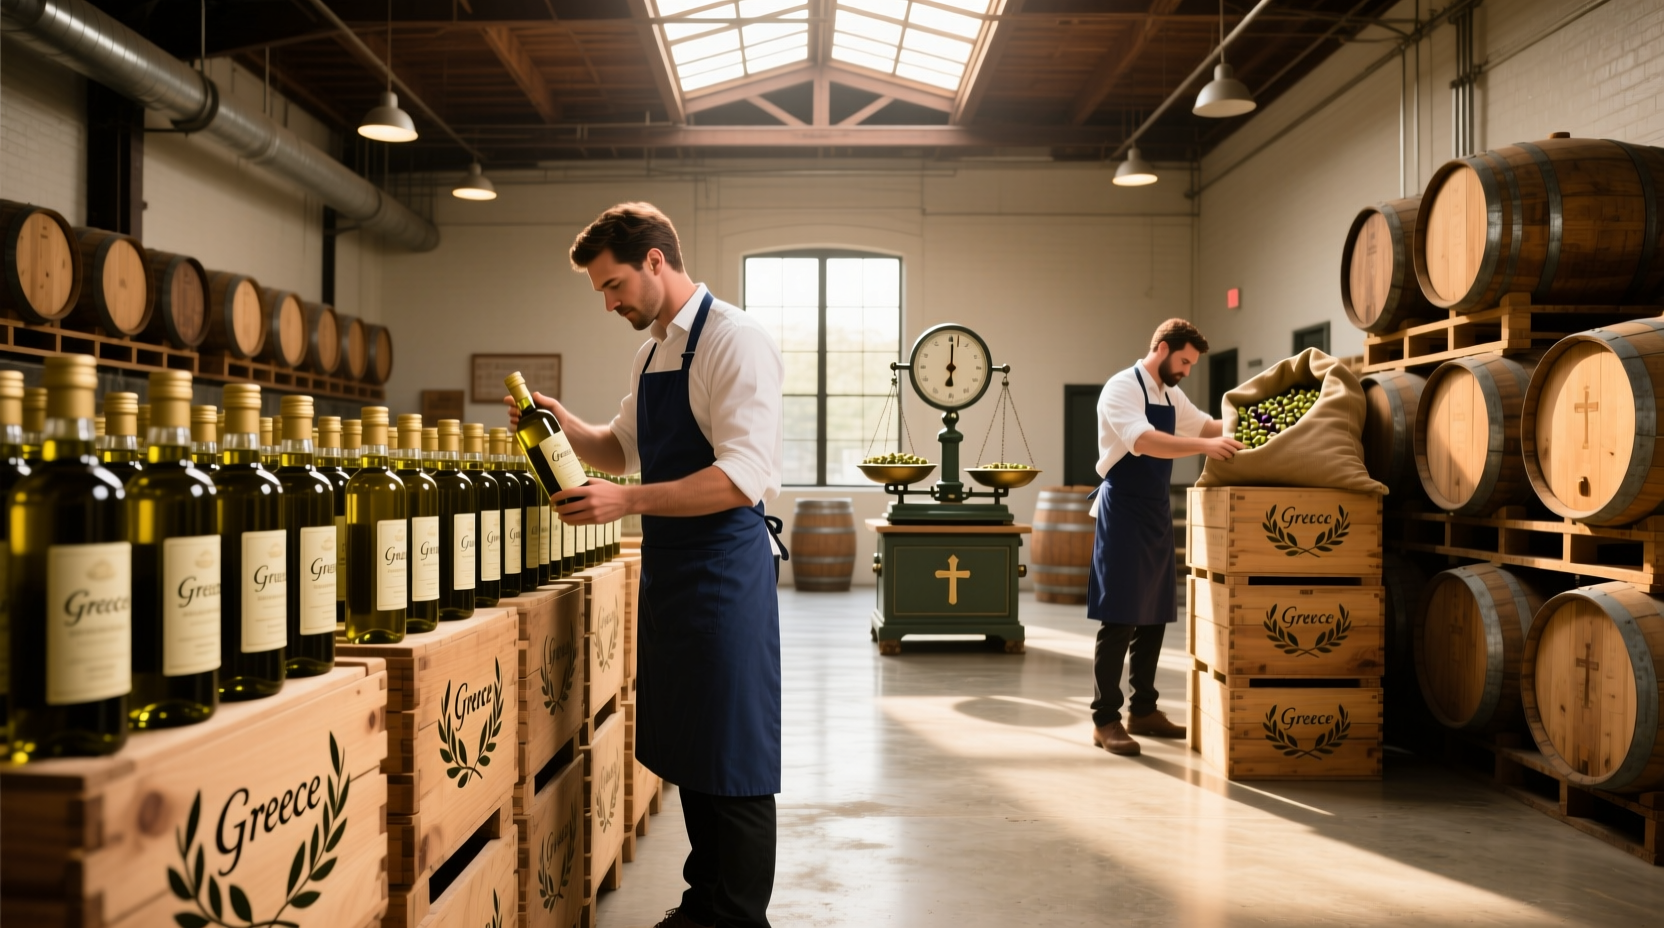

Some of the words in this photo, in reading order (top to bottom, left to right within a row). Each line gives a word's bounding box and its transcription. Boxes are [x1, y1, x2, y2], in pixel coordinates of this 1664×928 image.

[1282, 606, 1334, 629] Greece
[454, 682, 492, 732] Greece
[1281, 707, 1334, 730] Greece
[216, 775, 321, 877] Greece
